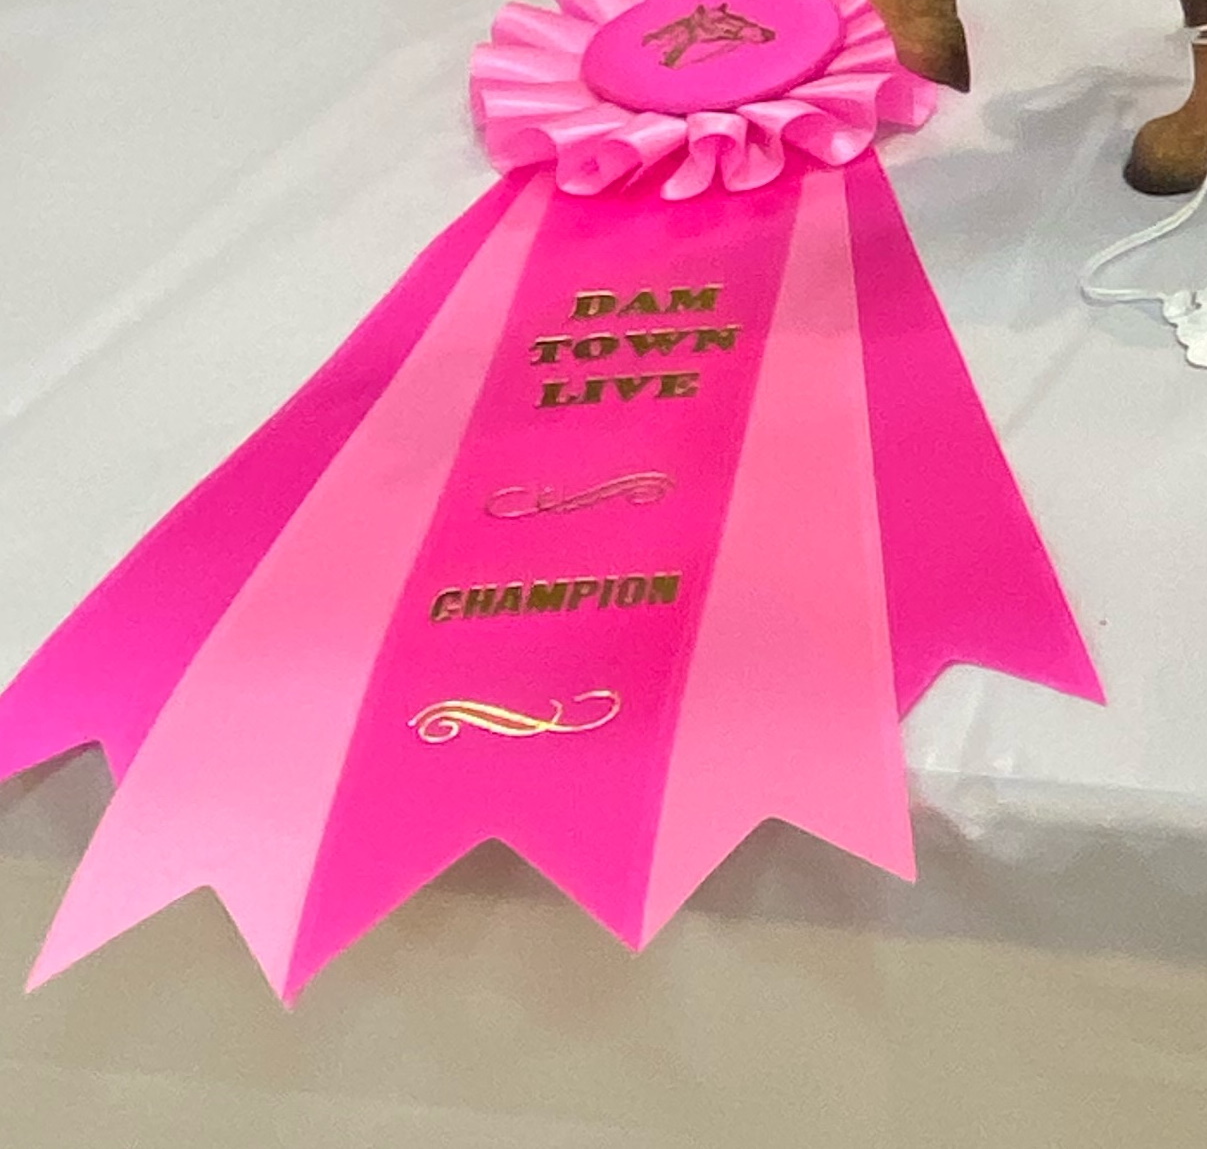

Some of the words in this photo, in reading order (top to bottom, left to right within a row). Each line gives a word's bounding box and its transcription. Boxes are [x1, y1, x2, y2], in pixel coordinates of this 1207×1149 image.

[570, 282, 724, 321] DAM
[529, 323, 741, 366] TOWN
[535, 371, 700, 409] LIVE
[428, 570, 684, 624] CHAMPION
